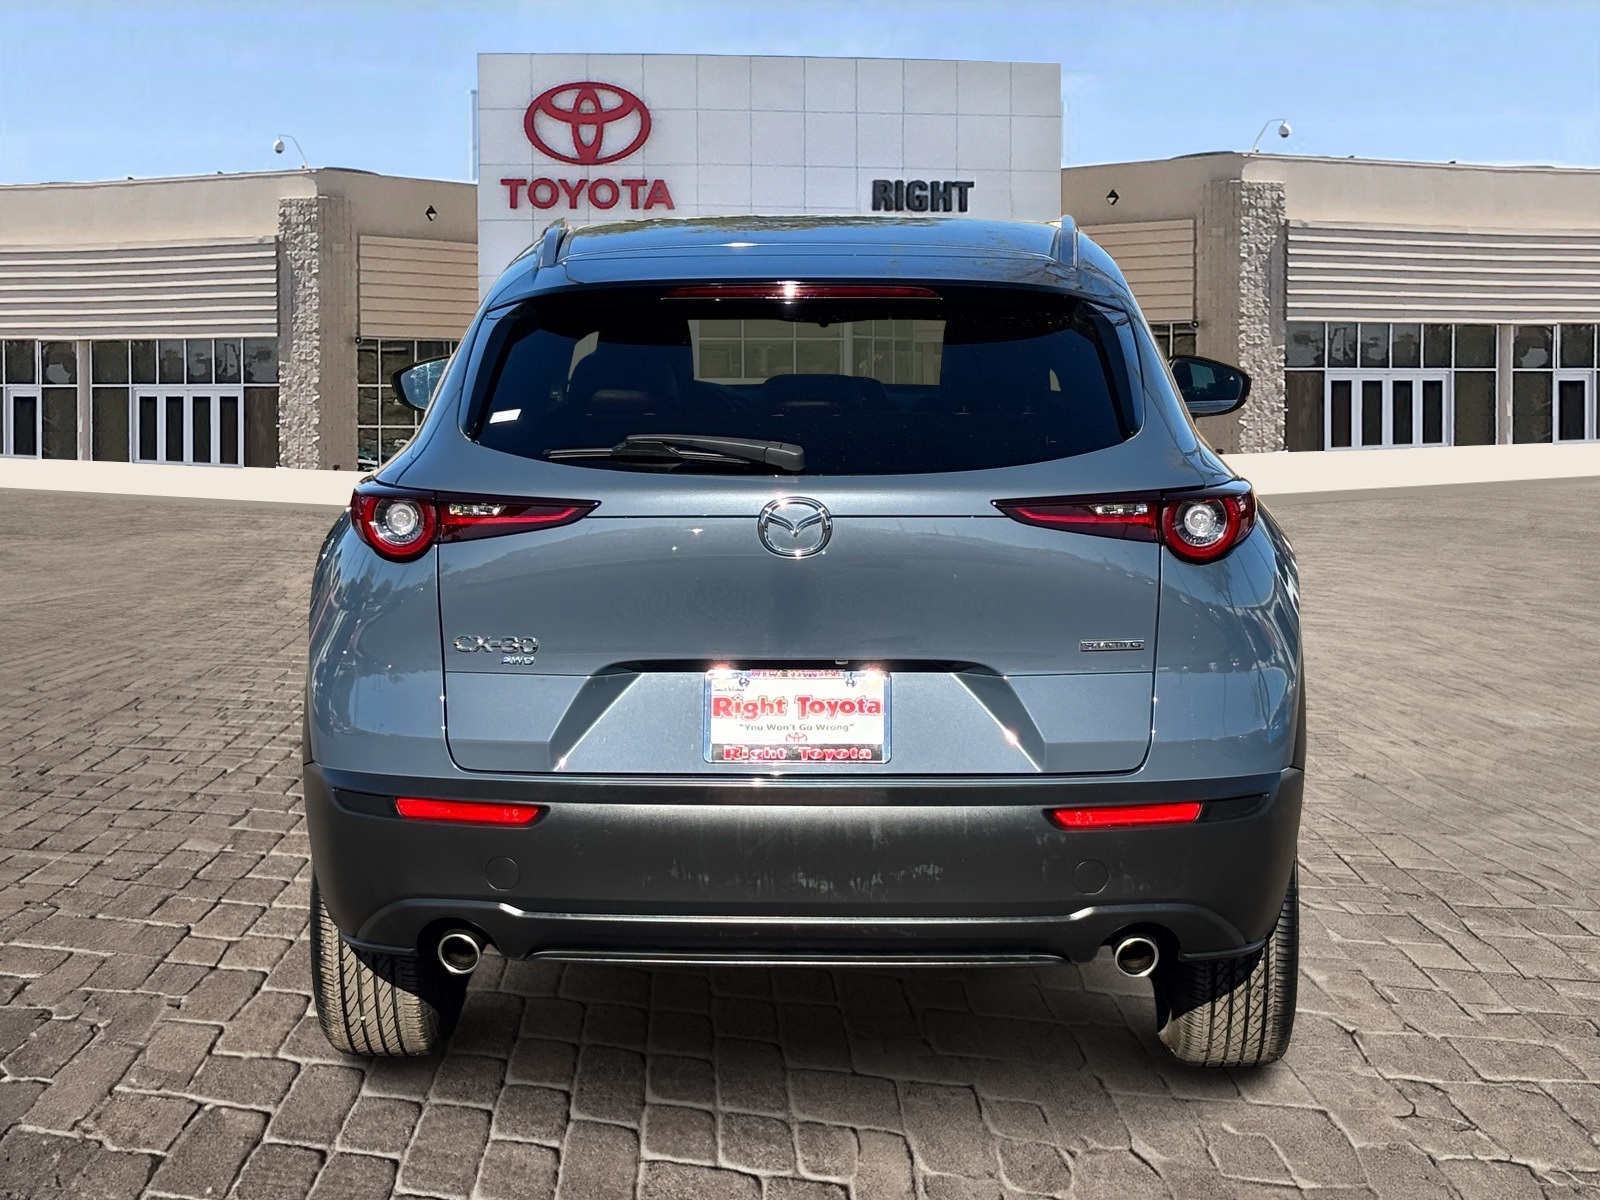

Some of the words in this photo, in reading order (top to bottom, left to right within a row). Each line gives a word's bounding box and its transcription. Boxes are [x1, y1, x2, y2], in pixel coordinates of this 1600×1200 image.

[500, 178, 675, 210] TOYOTA
[871, 179, 975, 213] RIGHT
[453, 635, 539, 655] CX-30
[501, 656, 536, 666] AWD
[711, 695, 788, 720] Right
[794, 695, 882, 718] Toyota
[766, 723, 797, 731] Won't
[724, 745, 787, 760] Right
[798, 746, 872, 760] Toyota
